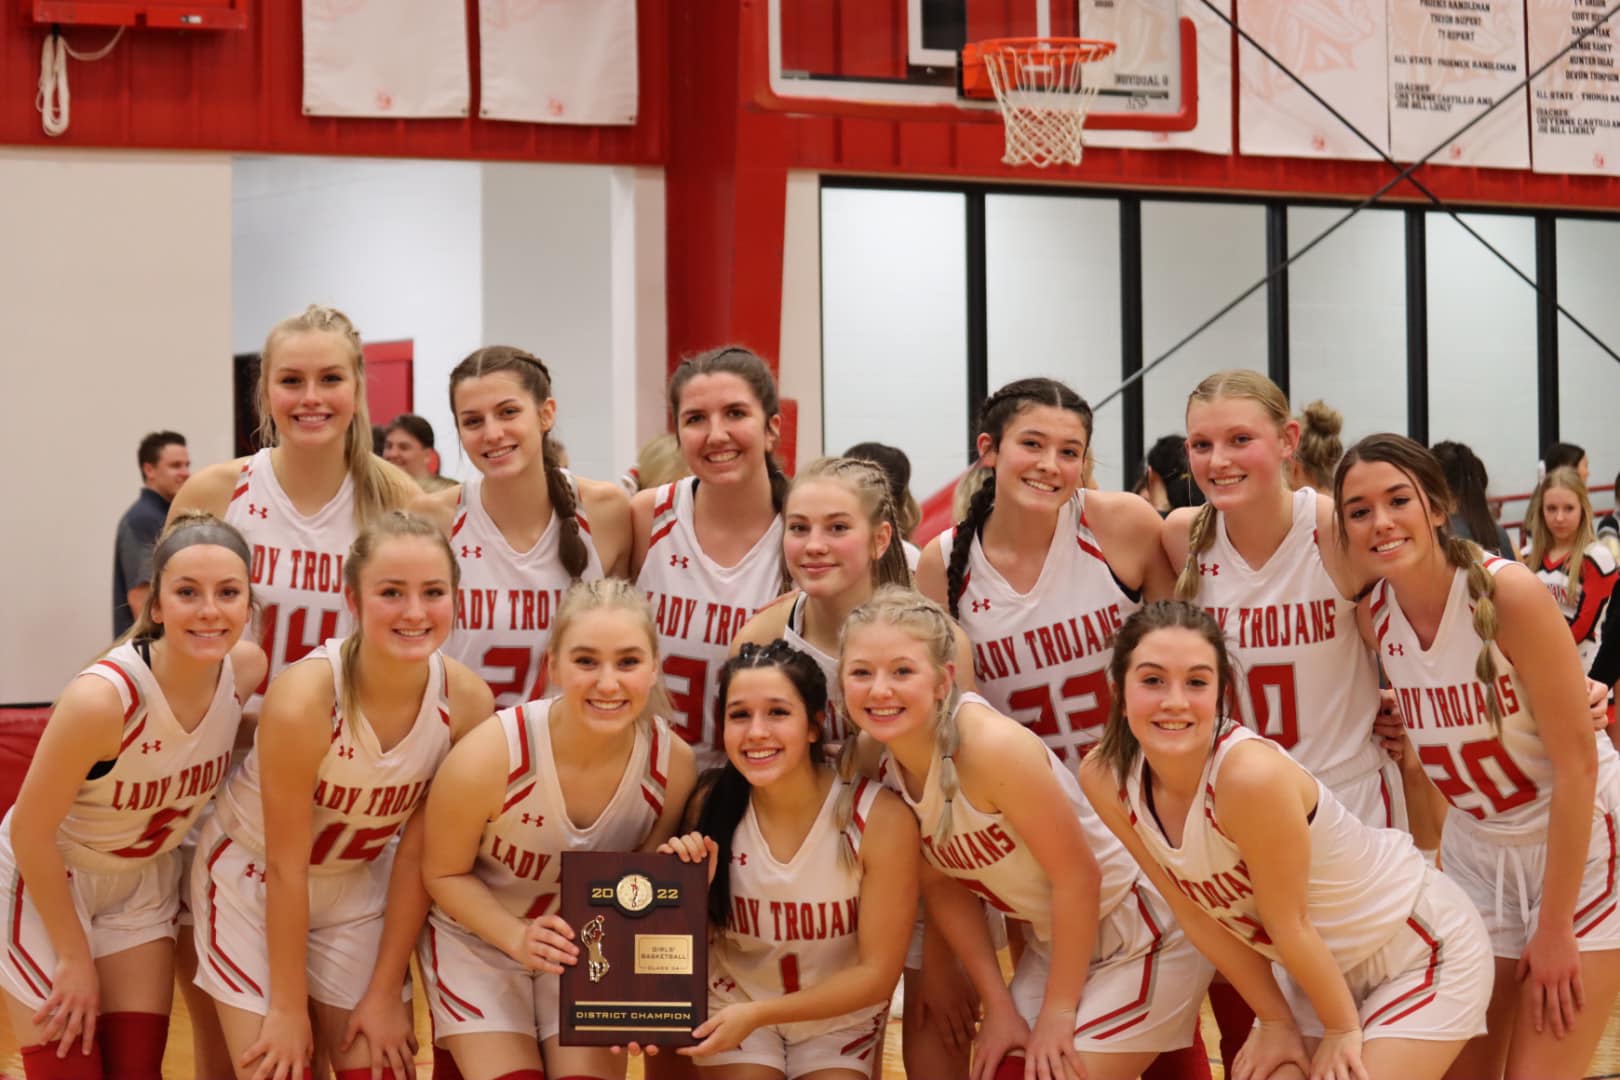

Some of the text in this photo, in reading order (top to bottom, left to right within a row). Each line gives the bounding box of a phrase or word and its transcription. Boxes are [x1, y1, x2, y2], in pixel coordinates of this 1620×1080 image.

[251, 543, 344, 594] DY TROJ
[456, 589, 498, 630] ADY
[1239, 598, 1336, 649] TROJANS
[1396, 688, 1425, 730] DY
[111, 751, 230, 812] LADY TROJ
[313, 778, 432, 817] ADY TROJ
[1418, 737, 1538, 821] 20
[491, 834, 553, 882] LADY
[592, 888, 679, 899] 20 22
[728, 895, 860, 942] DY TROJAN
[576, 1011, 691, 1020] DISTRICT CHAMPION
